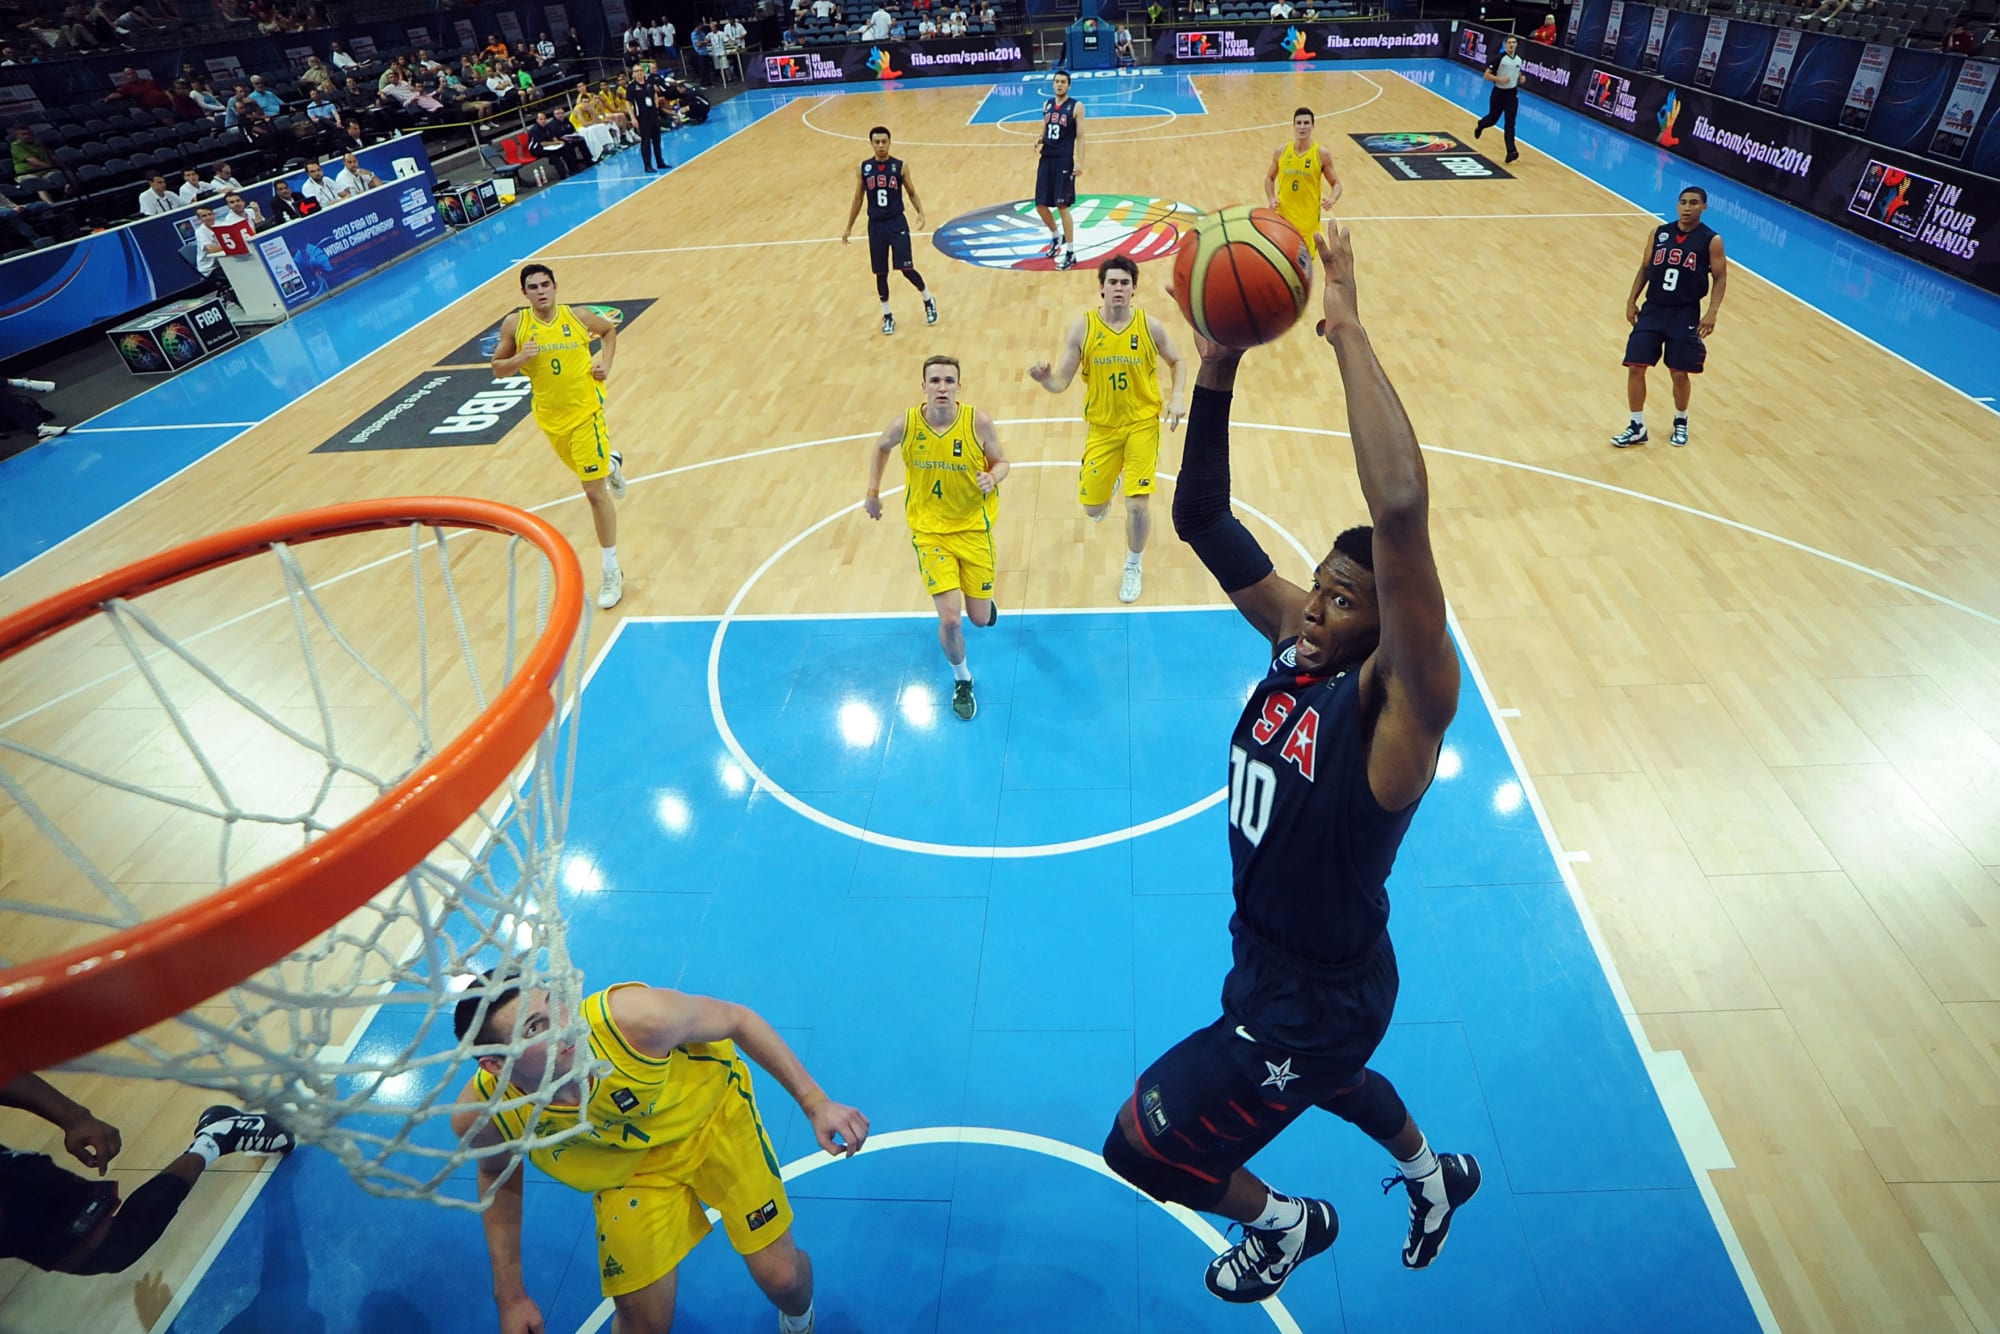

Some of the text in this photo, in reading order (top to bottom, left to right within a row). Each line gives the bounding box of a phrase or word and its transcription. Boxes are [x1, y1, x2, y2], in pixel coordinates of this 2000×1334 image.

[1225, 39, 1248, 48] YOUR
[1327, 32, 1438, 49] fiba.com/spain2014
[911, 47, 1021, 66] fiba.com/spain2014
[1225, 47, 1255, 57] HANDS
[812, 61, 835, 70] YOUR
[813, 68, 843, 79] HANDS
[1044, 113, 1068, 127] USA
[1048, 124, 1060, 140] 13
[1692, 116, 1812, 178] fiba.com/spain2014
[867, 175, 898, 190] USA
[1291, 180, 1299, 192] 6
[877, 189, 888, 207] 6
[1939, 183, 1963, 207] IN
[1932, 201, 1977, 235] YOUR
[221, 233, 236, 250] 5
[323, 238, 350, 257] WORLD
[348, 217, 395, 247] CHAMPIONSHIP
[1920, 223, 1980, 260] HANDS
[1653, 247, 1697, 272] USA
[1662, 267, 1679, 292] 9
[195, 306, 222, 329] FIBA
[551, 358, 561, 375] 9
[1093, 355, 1141, 366] AUSTRALIA
[1109, 372, 1128, 391] 15
[429, 376, 532, 434] FIBA
[914, 459, 967, 473] AUSTRALIA
[932, 479, 943, 499] 4
[1252, 690, 1320, 783] SA
[1230, 744, 1277, 848] 10
